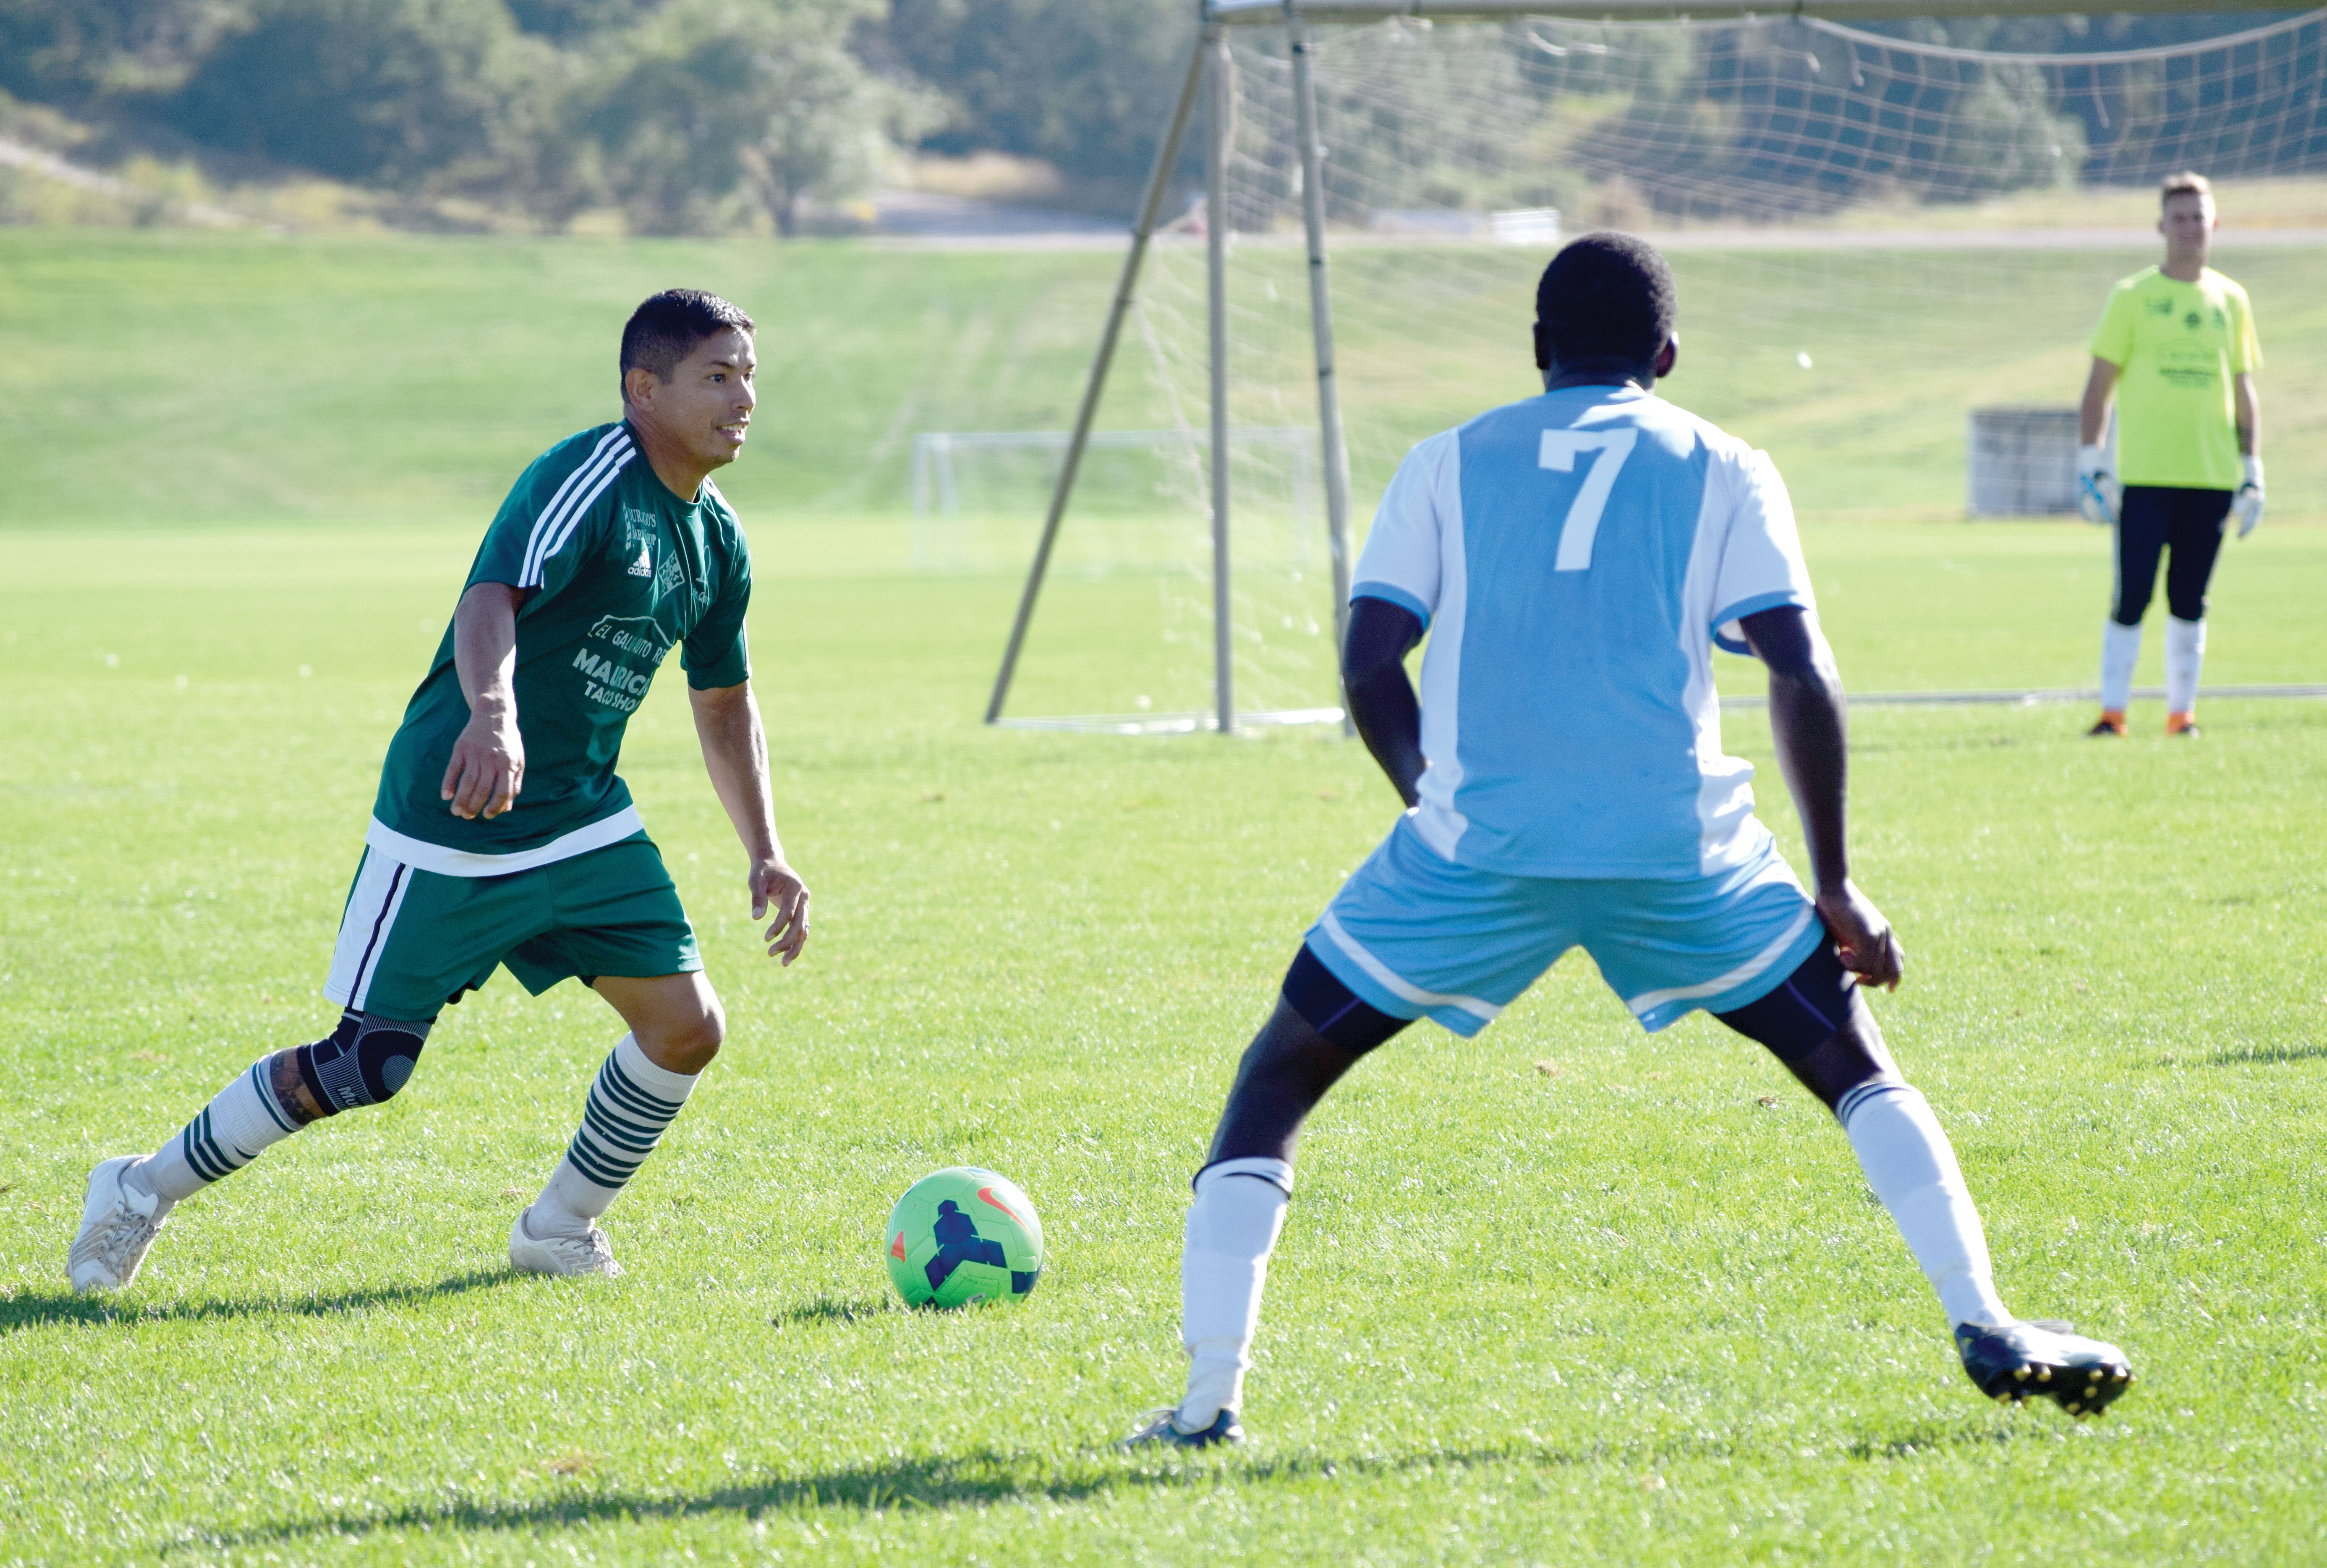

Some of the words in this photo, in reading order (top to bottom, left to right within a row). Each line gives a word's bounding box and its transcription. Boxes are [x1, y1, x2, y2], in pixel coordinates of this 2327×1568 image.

[1538, 427, 1638, 571] 7
[628, 567, 651, 578] adidas
[595, 625, 612, 639] EL
[337, 1086, 359, 1108] Mu
